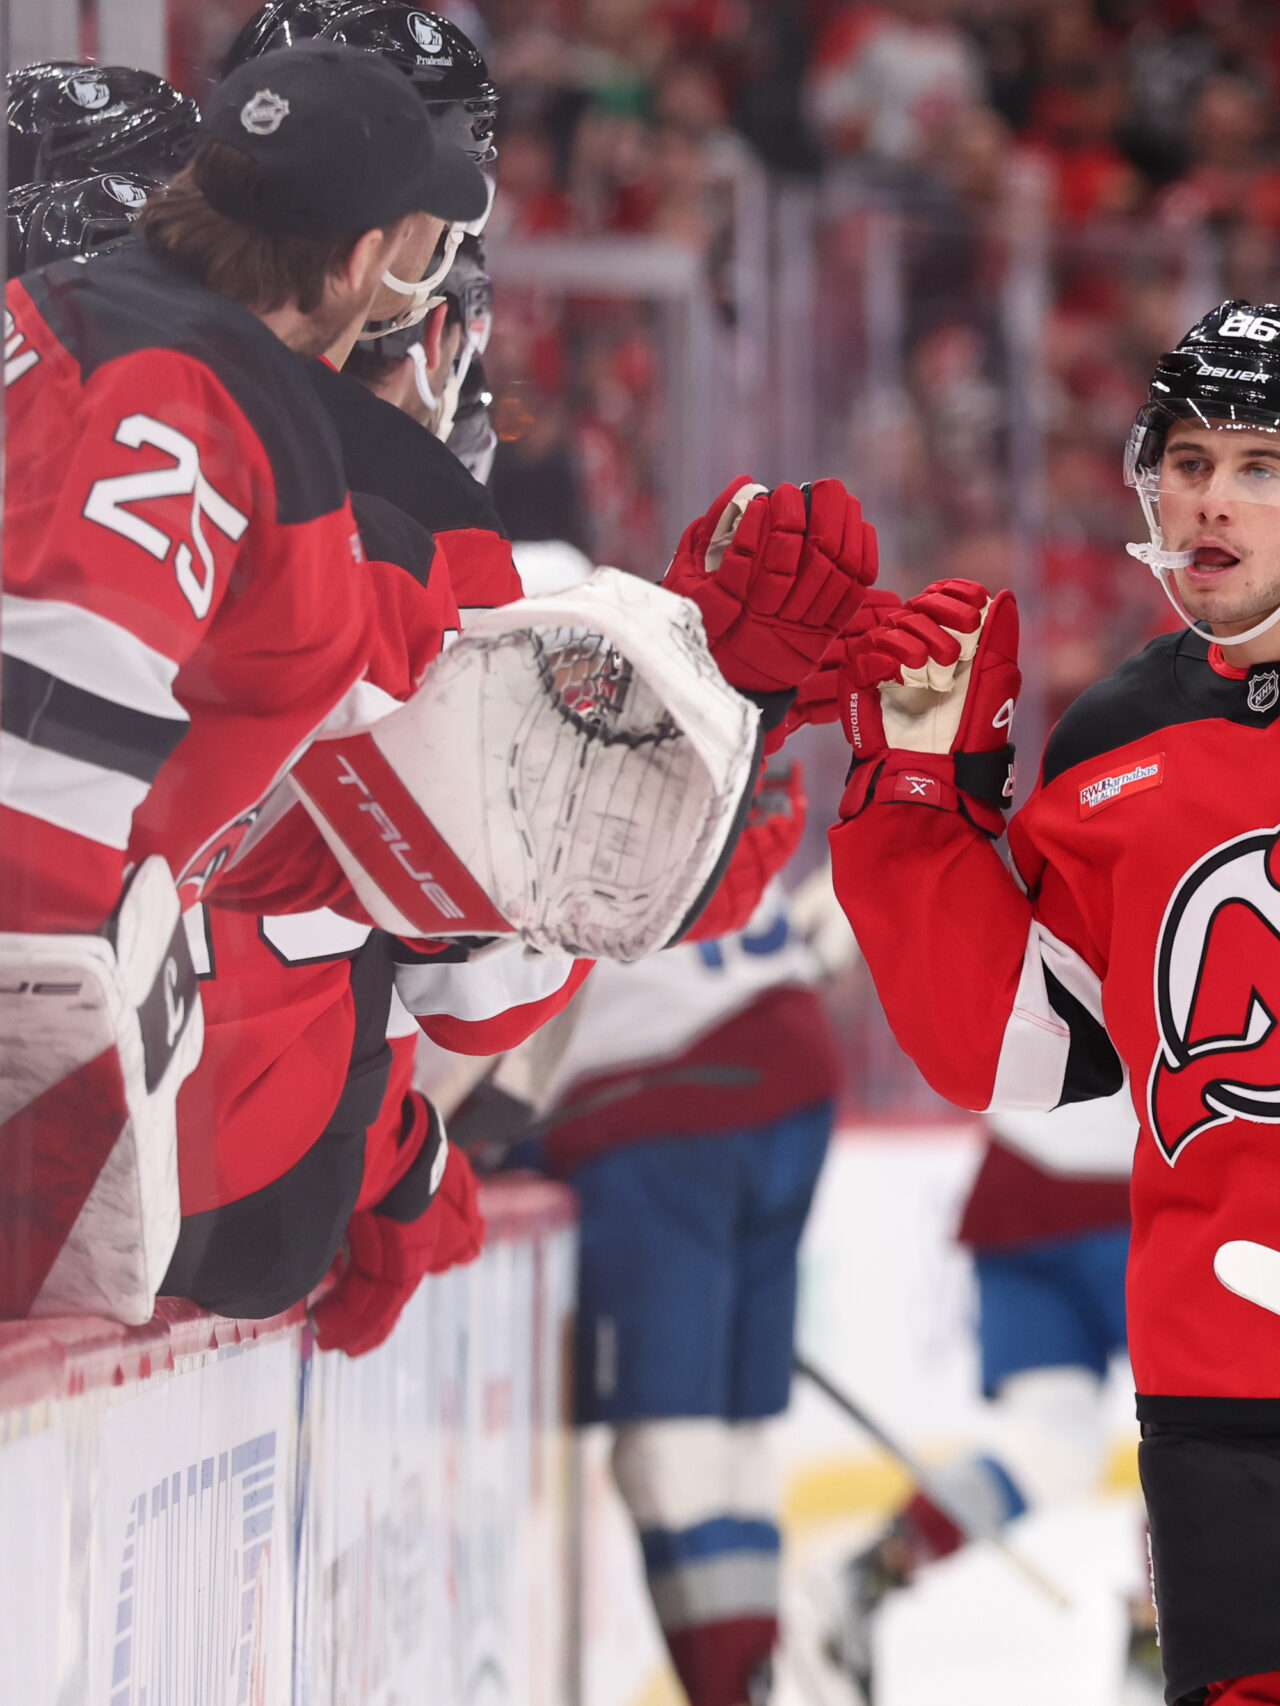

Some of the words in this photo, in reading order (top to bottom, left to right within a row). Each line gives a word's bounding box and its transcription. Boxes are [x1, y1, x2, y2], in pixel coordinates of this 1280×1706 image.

[416, 54, 454, 67] Prudential
[1196, 366, 1271, 384] BAUER
[850, 692, 863, 749] JHUGHES
[1089, 785, 1121, 807] HEALTH
[336, 754, 466, 919] TRUE
